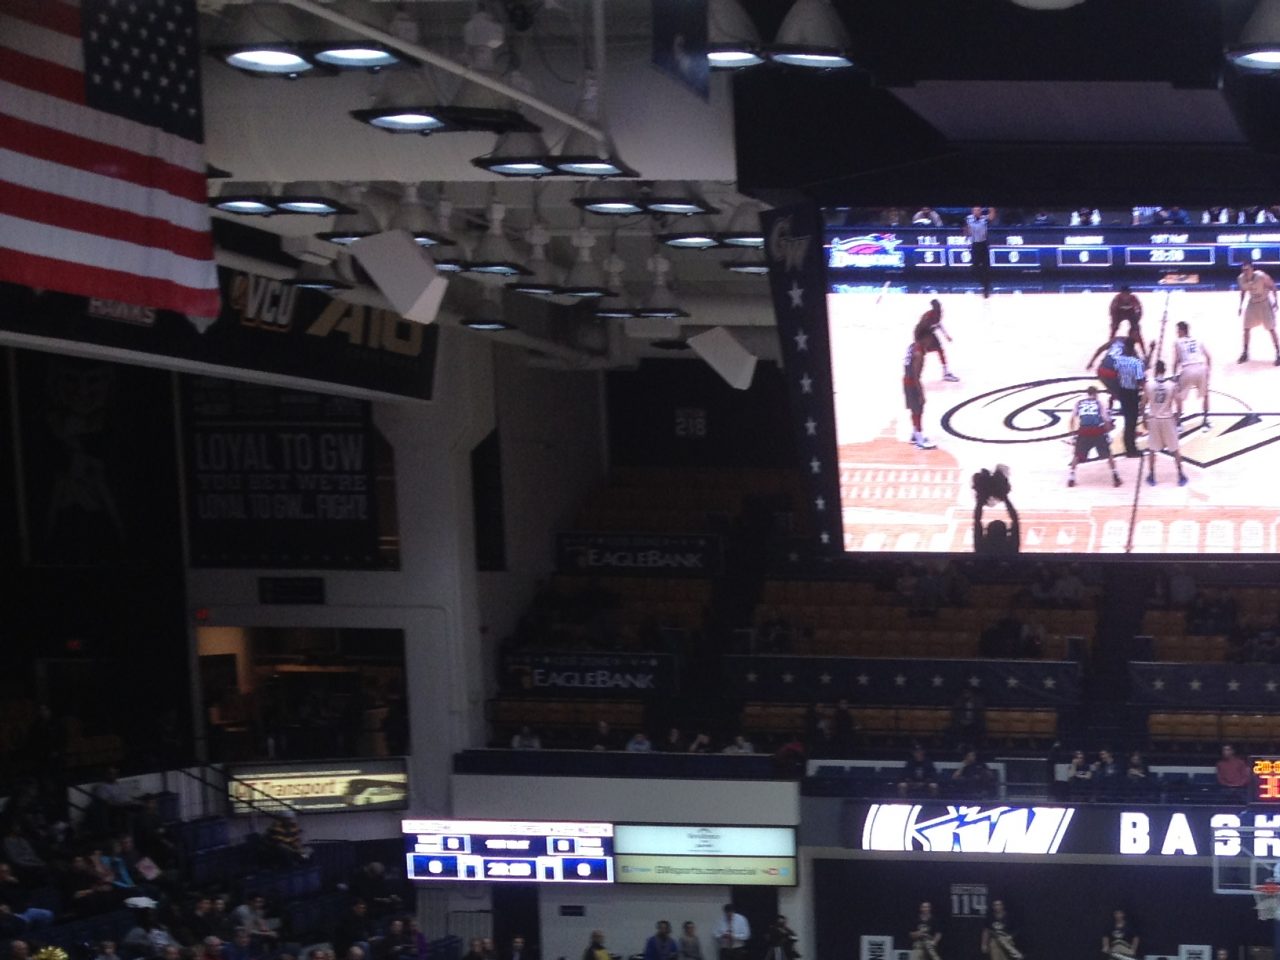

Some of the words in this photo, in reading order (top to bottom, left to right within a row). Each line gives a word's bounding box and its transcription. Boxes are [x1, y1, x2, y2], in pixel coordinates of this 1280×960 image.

[243, 274, 297, 332] VCU
[195, 432, 274, 470] LOYAL
[280, 432, 314, 470] TO
[320, 432, 364, 471] GW
[951, 895, 987, 915] 114
